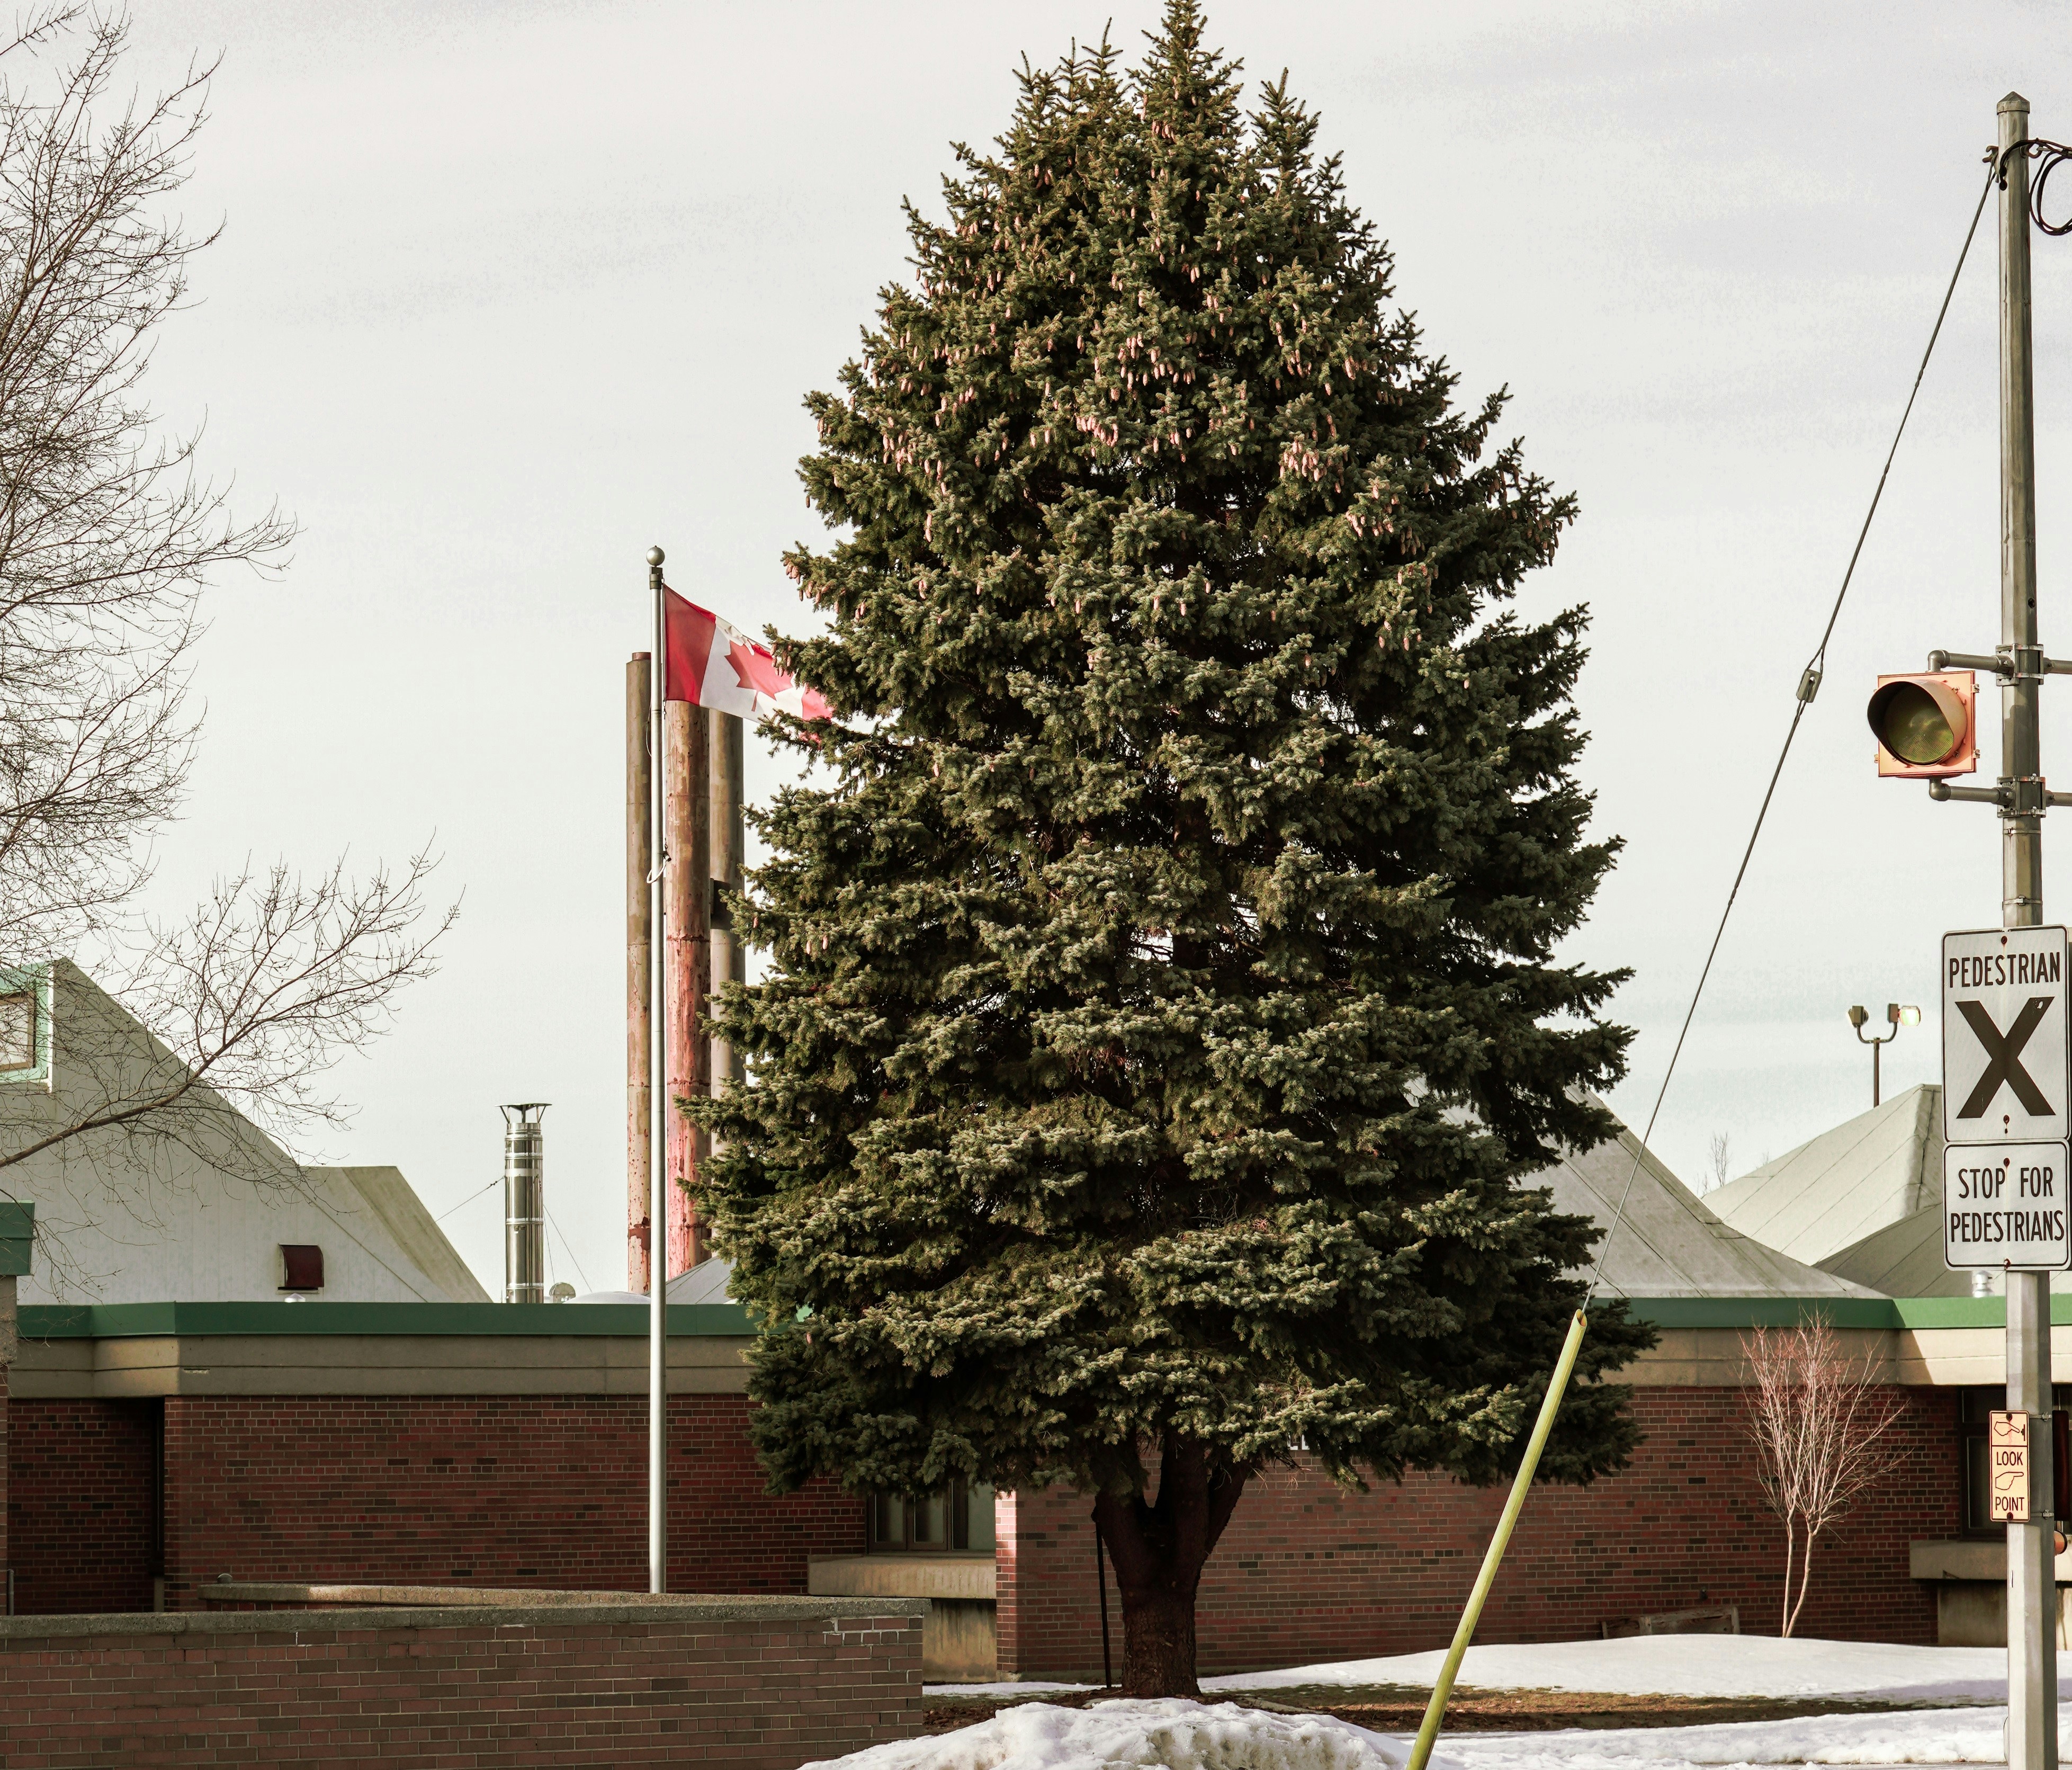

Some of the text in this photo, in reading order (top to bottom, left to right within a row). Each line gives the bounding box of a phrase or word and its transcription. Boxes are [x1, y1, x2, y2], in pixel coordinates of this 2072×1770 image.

[1949, 952, 2060, 988] PEDESTRIAN
[1954, 996, 2057, 1119] X
[1959, 1167, 2053, 1199] STOP FOR
[1951, 1210, 2065, 1242] PEDESTRIANS
[1996, 1451, 2023, 1466] LOOK
[1995, 1497, 2025, 1511] POINT
